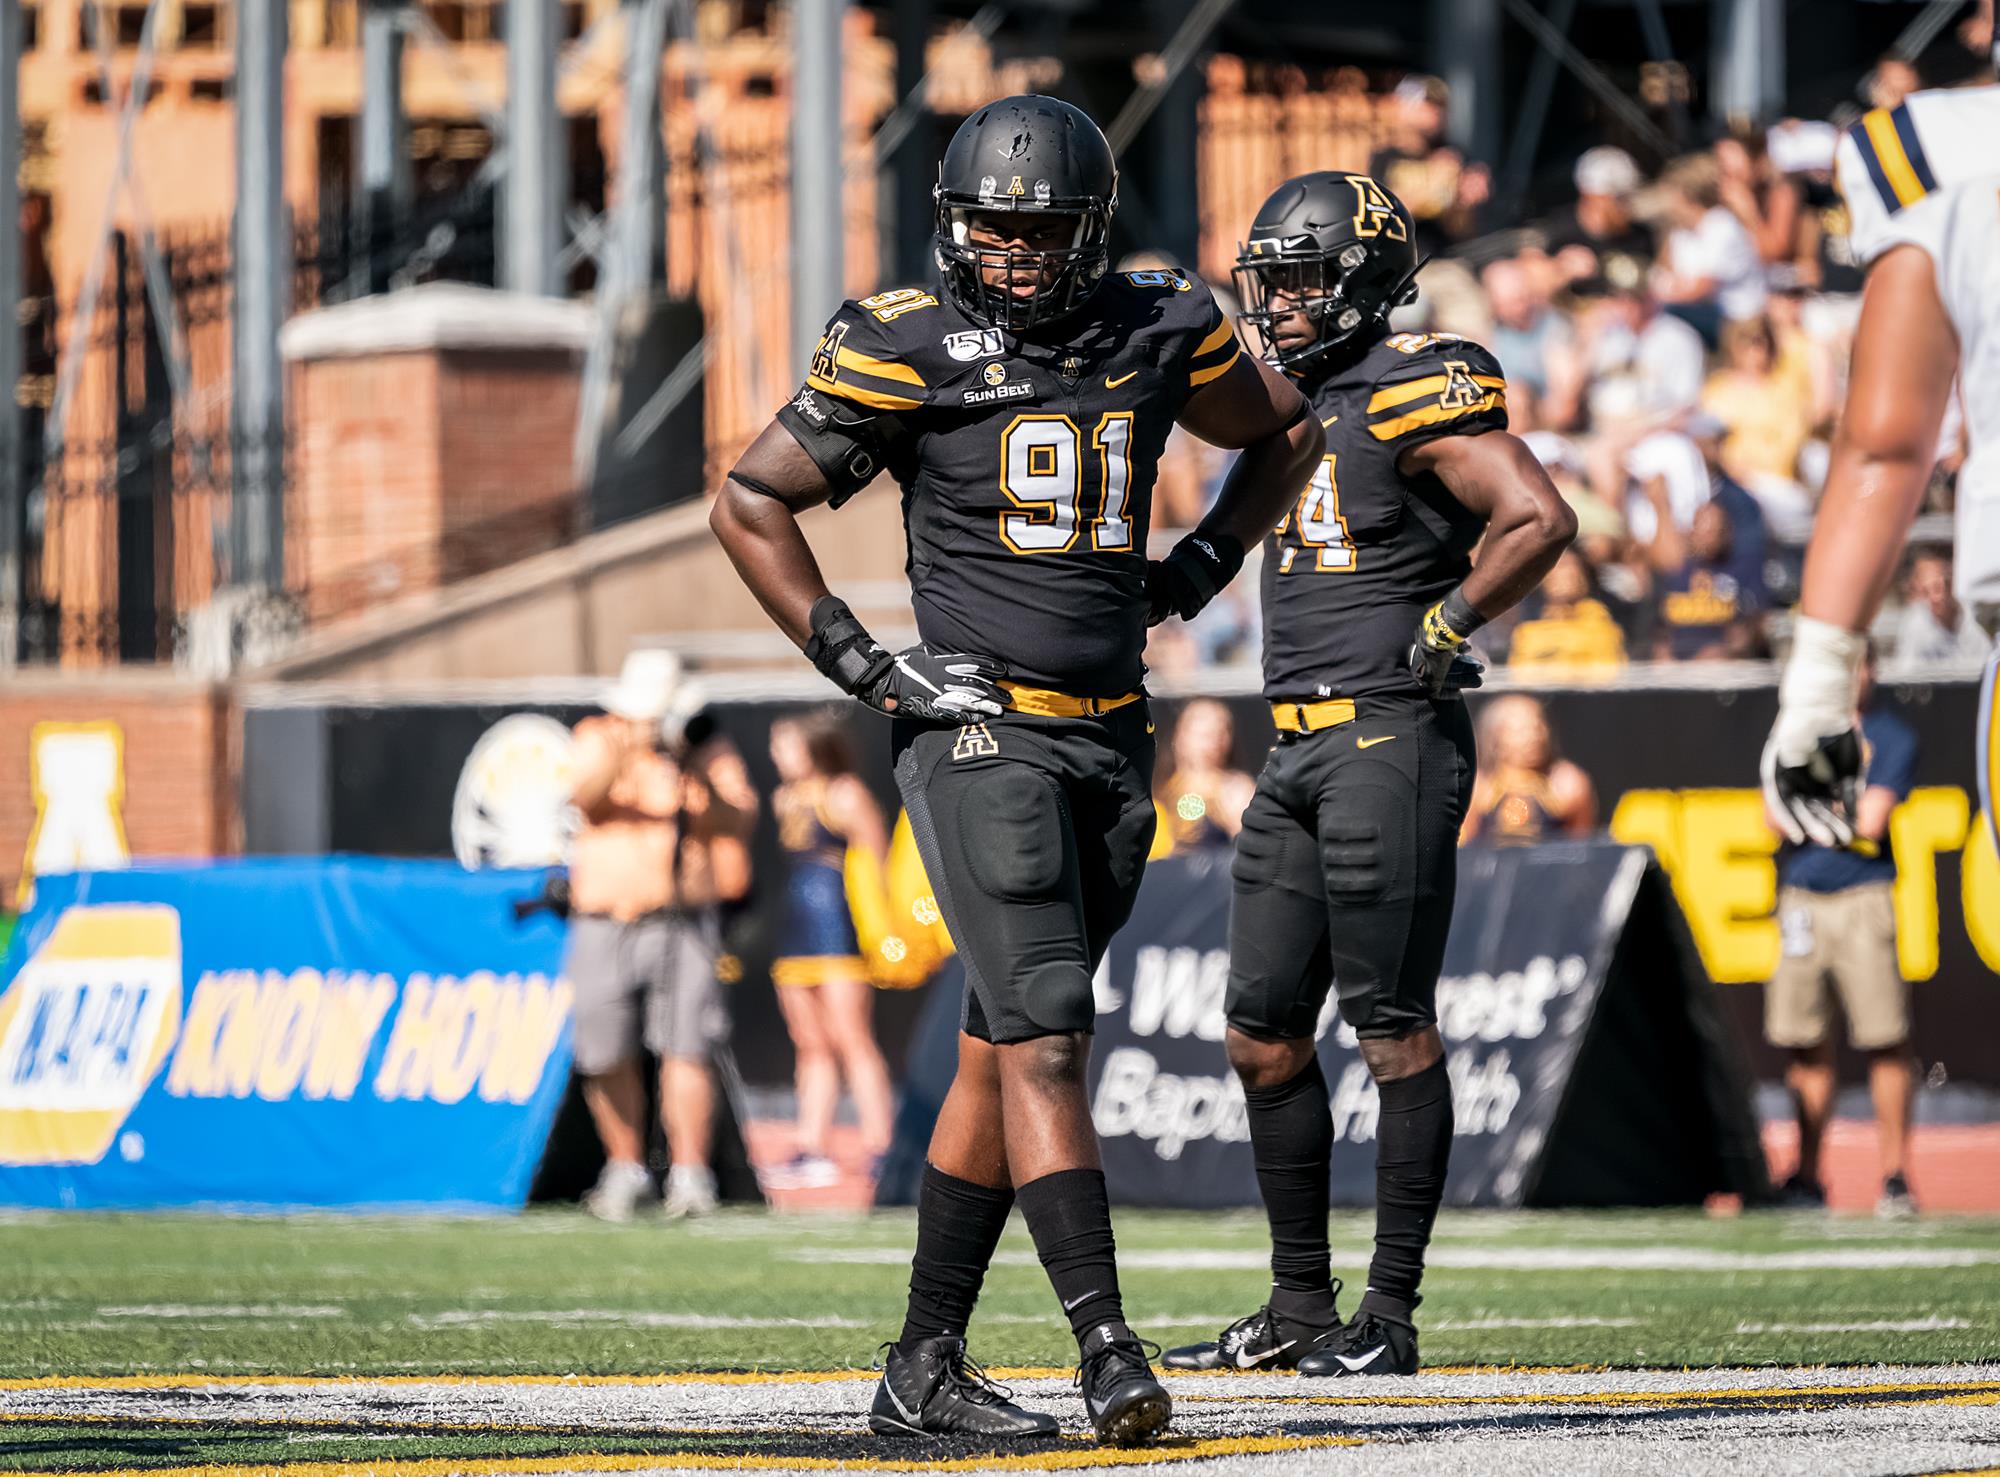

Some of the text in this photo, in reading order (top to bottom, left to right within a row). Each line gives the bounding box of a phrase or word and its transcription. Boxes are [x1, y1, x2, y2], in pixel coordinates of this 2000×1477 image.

[1007, 175, 1025, 195] A
[1344, 175, 1408, 242] A
[858, 288, 939, 323] 91
[810, 319, 850, 385] A
[1440, 360, 1485, 410] A
[1000, 411, 1134, 555] 91
[1273, 453, 1358, 573] 4
[953, 723, 999, 760] A
[163, 966, 575, 1105] KNOW HOW
